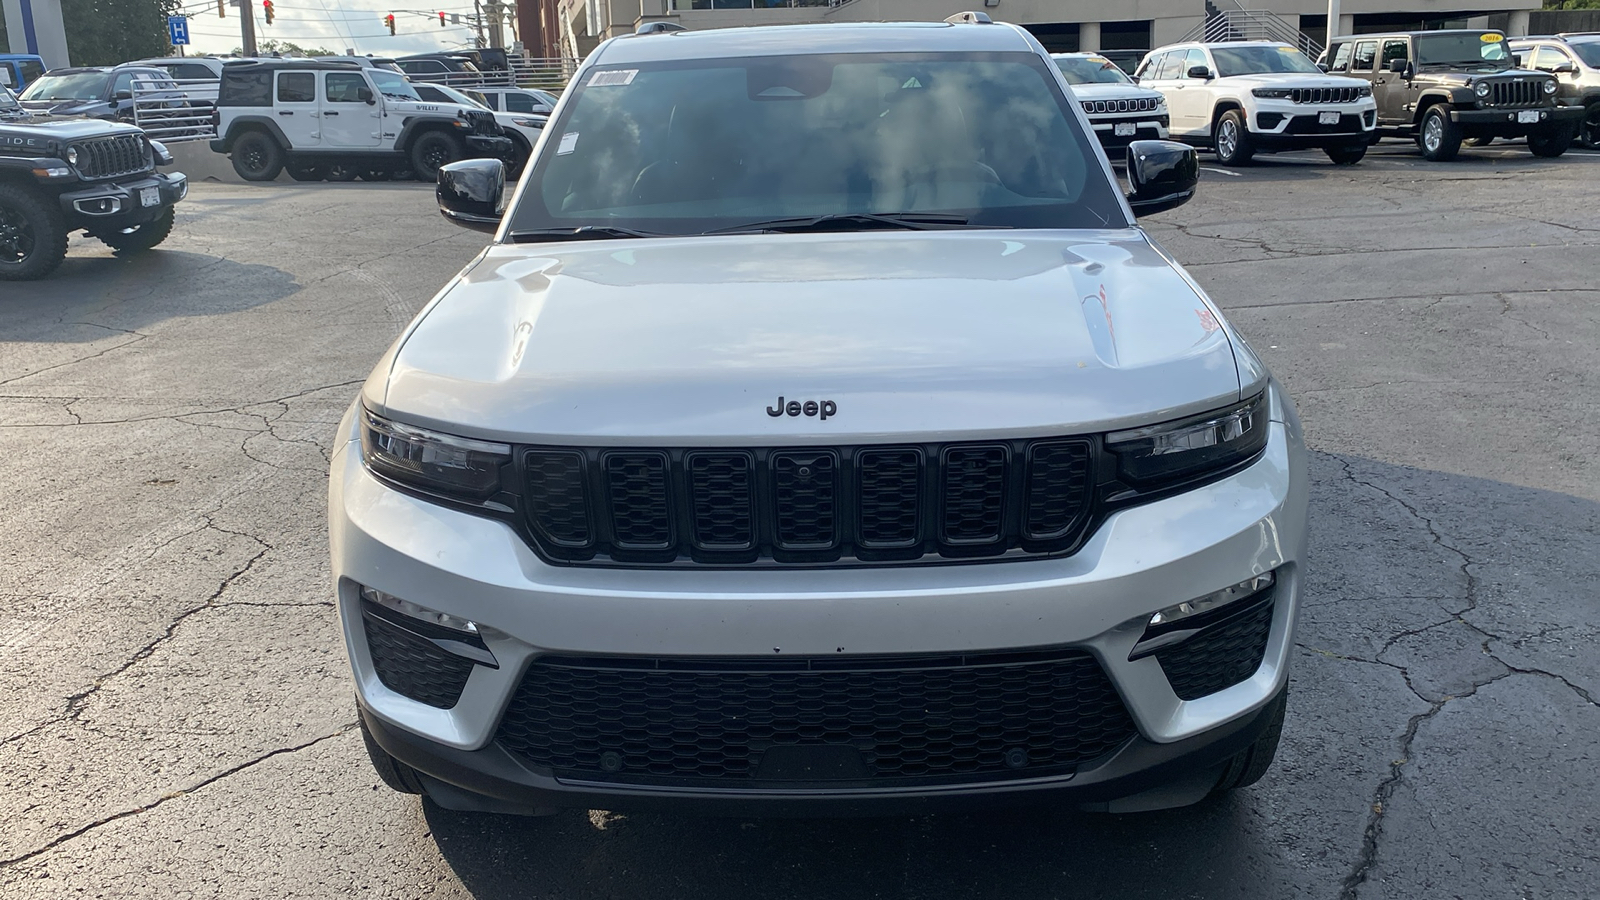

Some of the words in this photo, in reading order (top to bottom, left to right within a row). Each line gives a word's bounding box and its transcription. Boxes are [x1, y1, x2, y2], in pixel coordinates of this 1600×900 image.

[173, 23, 185, 37] H
[0, 136, 36, 146] IDE
[766, 396, 837, 421] Jeep
